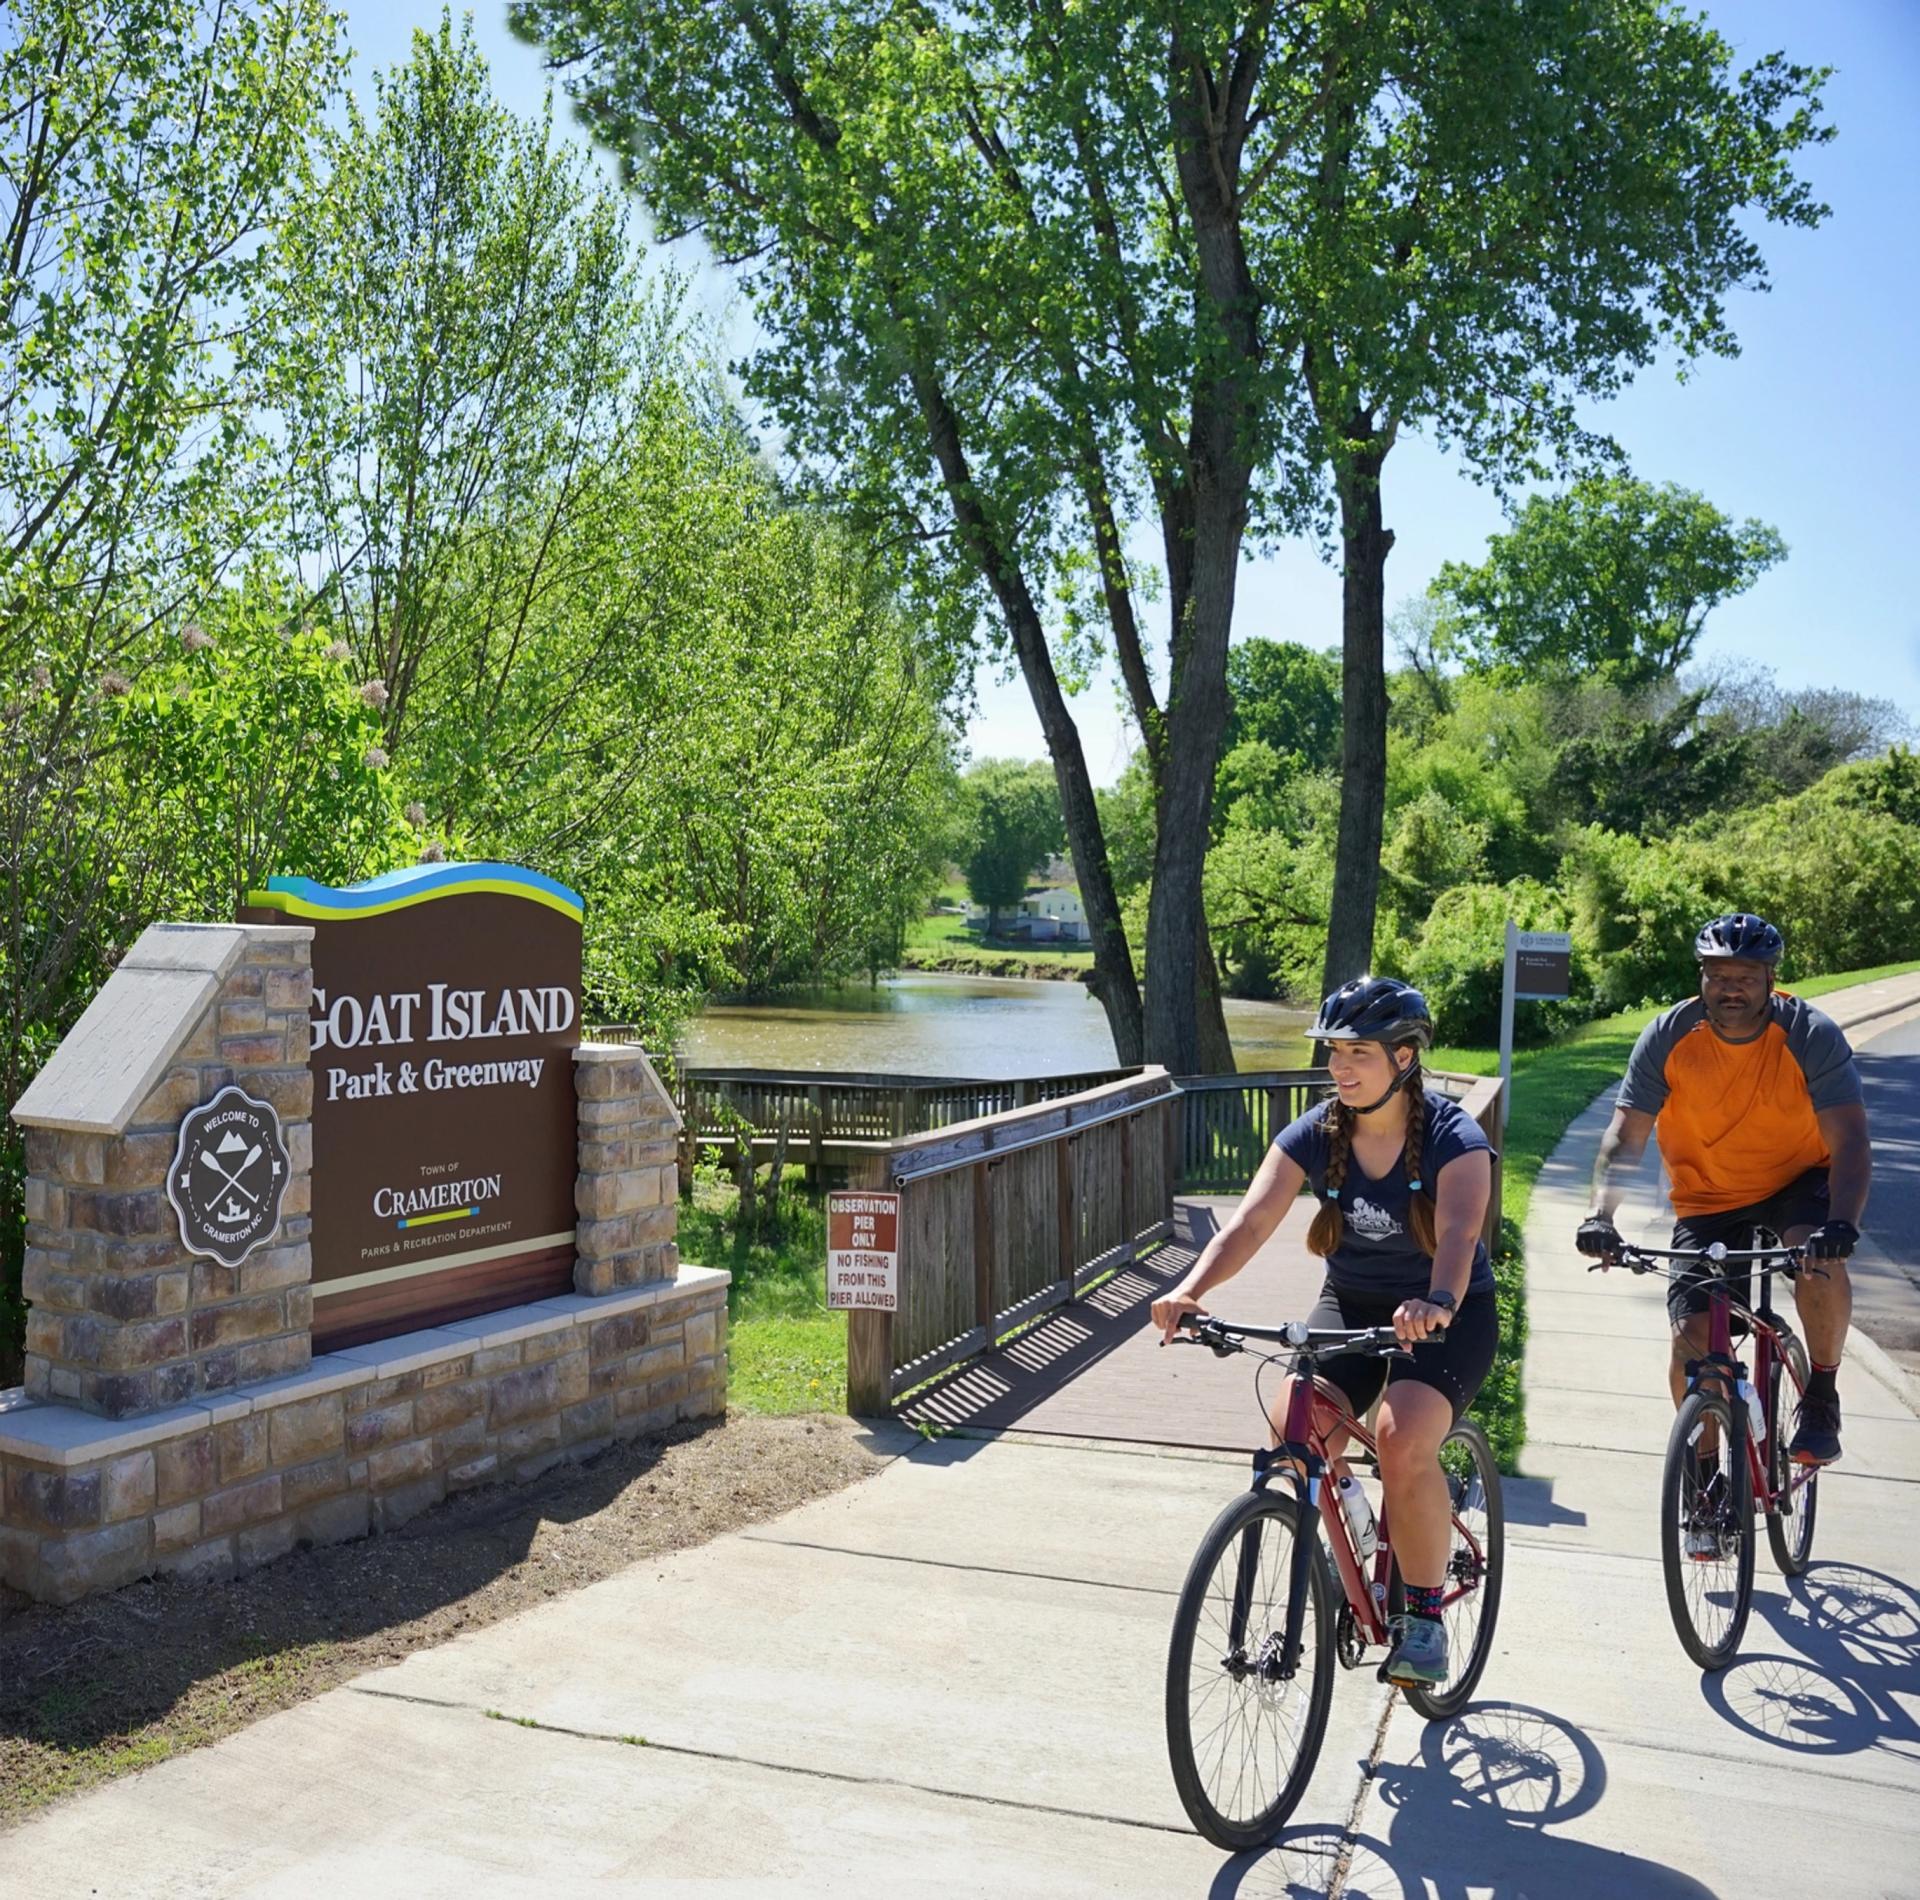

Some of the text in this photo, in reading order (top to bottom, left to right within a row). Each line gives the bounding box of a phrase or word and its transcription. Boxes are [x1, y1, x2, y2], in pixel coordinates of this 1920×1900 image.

[426, 983, 575, 1041] ISLAND
[326, 1057, 545, 1101] Park & Greenway
[203, 1110, 260, 1133] WELCOME TO
[420, 1162, 460, 1176] TOWN OF
[373, 1174, 501, 1218] CRAMERTON
[830, 1198, 896, 1214] OBSERVATION
[202, 1212, 263, 1243] CRAMERTON NC
[853, 1215, 875, 1230] PIER
[361, 1221, 512, 1259] PARKS & RECREATION DEPARTMENT
[852, 1232, 876, 1247] ONLY
[837, 1254, 889, 1269] NO FISHING
[838, 1272, 887, 1288] FROM THIS
[830, 1291, 896, 1307] PIER ALLOWED
